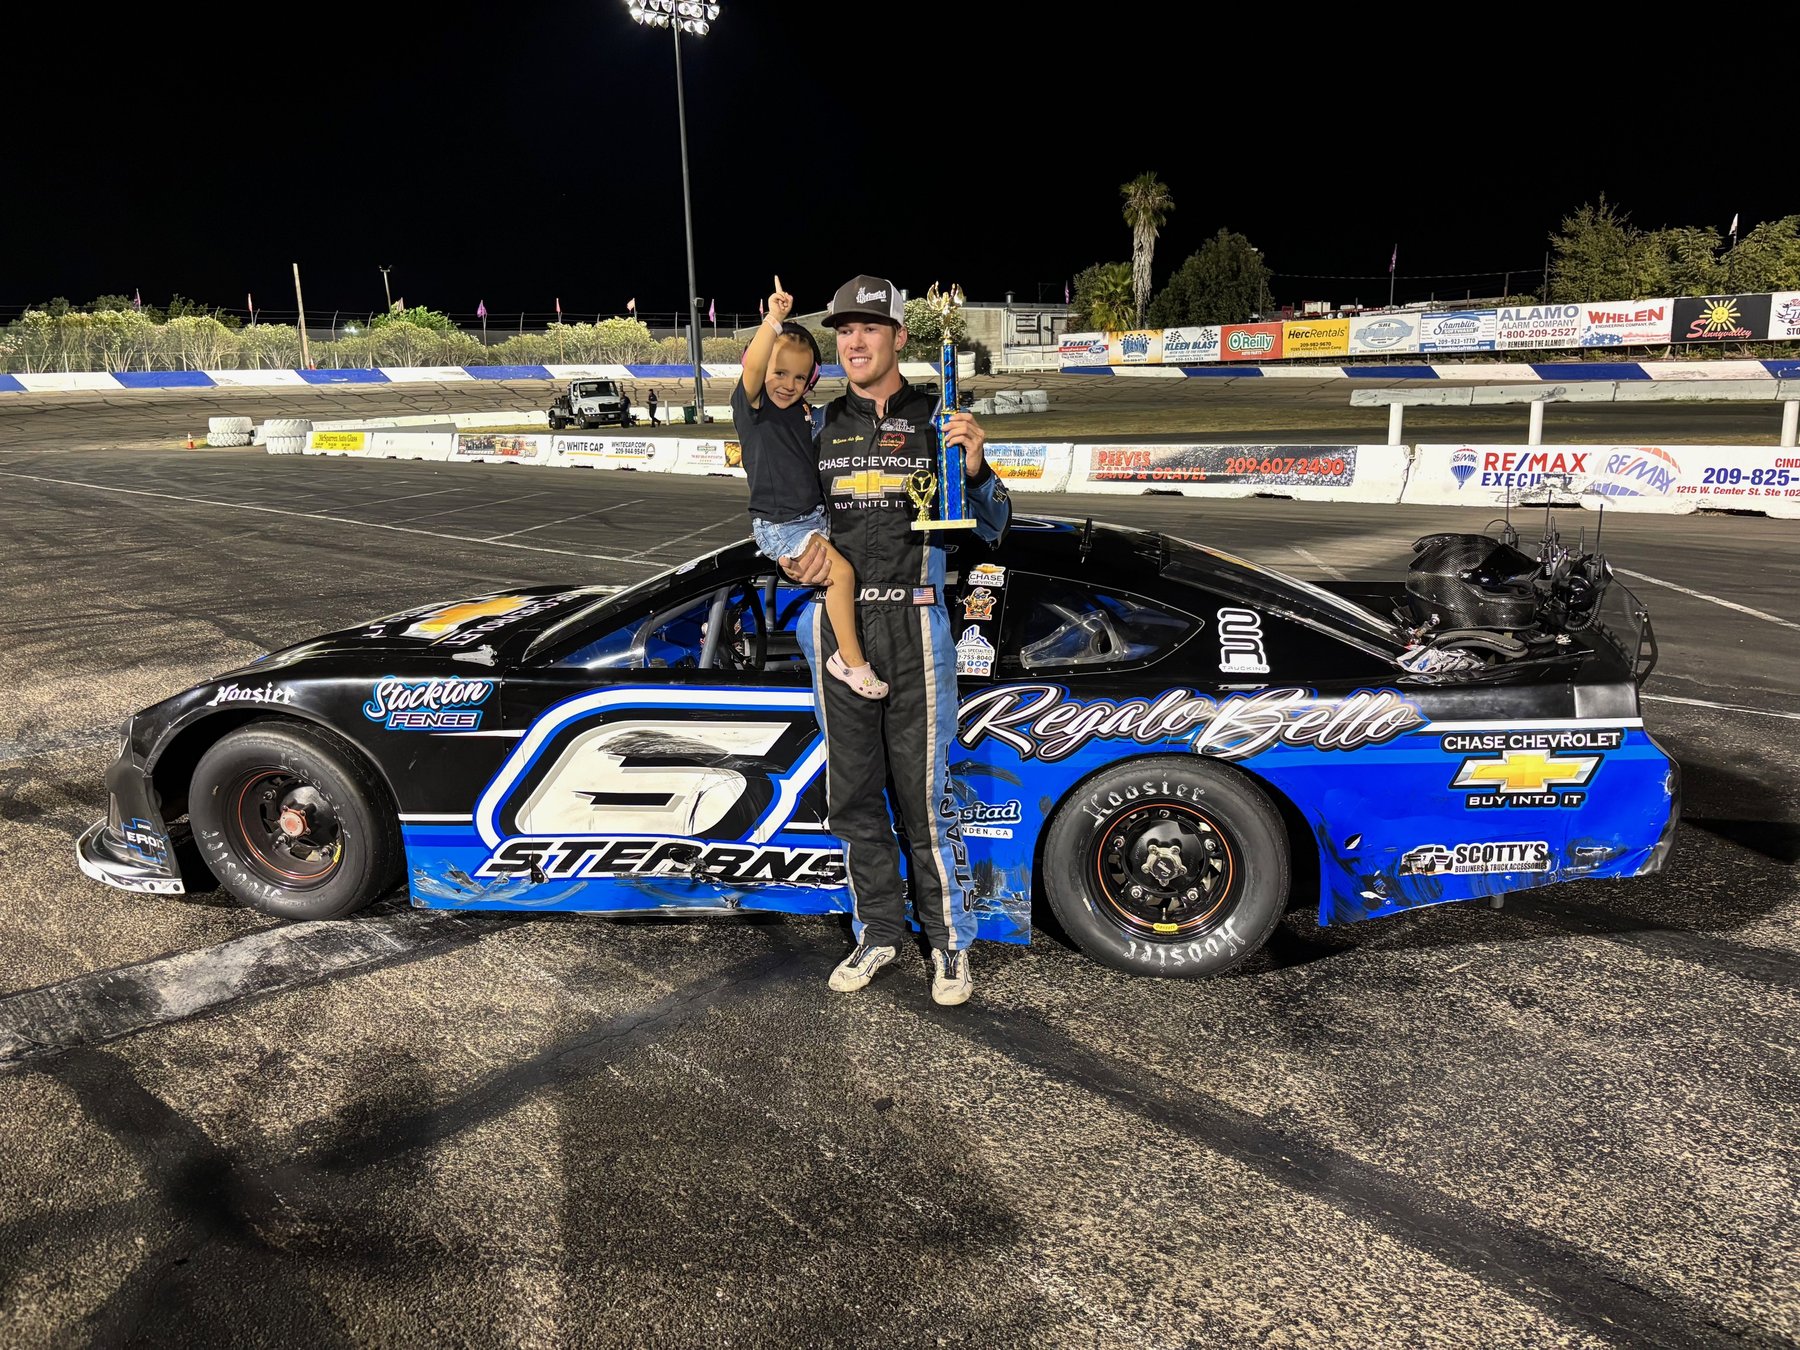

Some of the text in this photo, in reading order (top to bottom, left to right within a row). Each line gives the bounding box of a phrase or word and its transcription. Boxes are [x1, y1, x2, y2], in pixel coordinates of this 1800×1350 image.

[1499, 305, 1579, 321] ALAMO
[1588, 306, 1664, 324] WHELEN
[1433, 321, 1475, 335] Shamblin
[1502, 321, 1530, 330] ALARM
[1532, 319, 1575, 328] COMPANY
[1229, 331, 1274, 350] O'Reilly
[1288, 328, 1345, 339] HercRentals
[1498, 328, 1577, 339] 1-800-209-2527
[1165, 340, 1218, 351] KLEEN BLAST
[1508, 340, 1534, 348] REMEMBER
[567, 442, 604, 452] WHITE CAP
[818, 456, 932, 471] CHASE CHEVROLET
[1097, 451, 1151, 466] REEVES
[1453, 454, 1477, 463] RE/MAX
[1484, 452, 1588, 472] RE/MAX
[1152, 467, 1207, 480] GRAVEL
[1481, 472, 1573, 487] EXECU
[1605, 454, 1677, 494] RE/MAX
[1702, 467, 1800, 486] 209-825-
[1676, 486, 1697, 494] 1215
[1700, 486, 1710, 494] W.
[1713, 486, 1746, 495] Center
[1748, 487, 1761, 496] St.
[1764, 488, 1780, 496] Ste
[834, 500, 906, 510] BUY INTO IT
[969, 573, 1003, 581] CHASE
[855, 588, 906, 601] JOJO
[205, 682, 298, 707] Hoosier
[366, 678, 490, 718] Stockton
[387, 713, 477, 727] FENCE
[957, 685, 1418, 760] Regalo Bello
[1444, 733, 1621, 750] CHASE CHEVROLET
[514, 719, 792, 836] 6
[1082, 780, 1207, 829] Hoosier
[1469, 795, 1582, 806] BUY INTO IT
[1455, 843, 1547, 864] SCOTTY'S
[486, 841, 848, 886] STEARNS
[1454, 864, 1485, 873] BEDLINERS
[1490, 863, 1509, 872] TRUCK
[1509, 860, 1548, 870] ACCESSORIES
[1123, 916, 1246, 968] Hoosier
